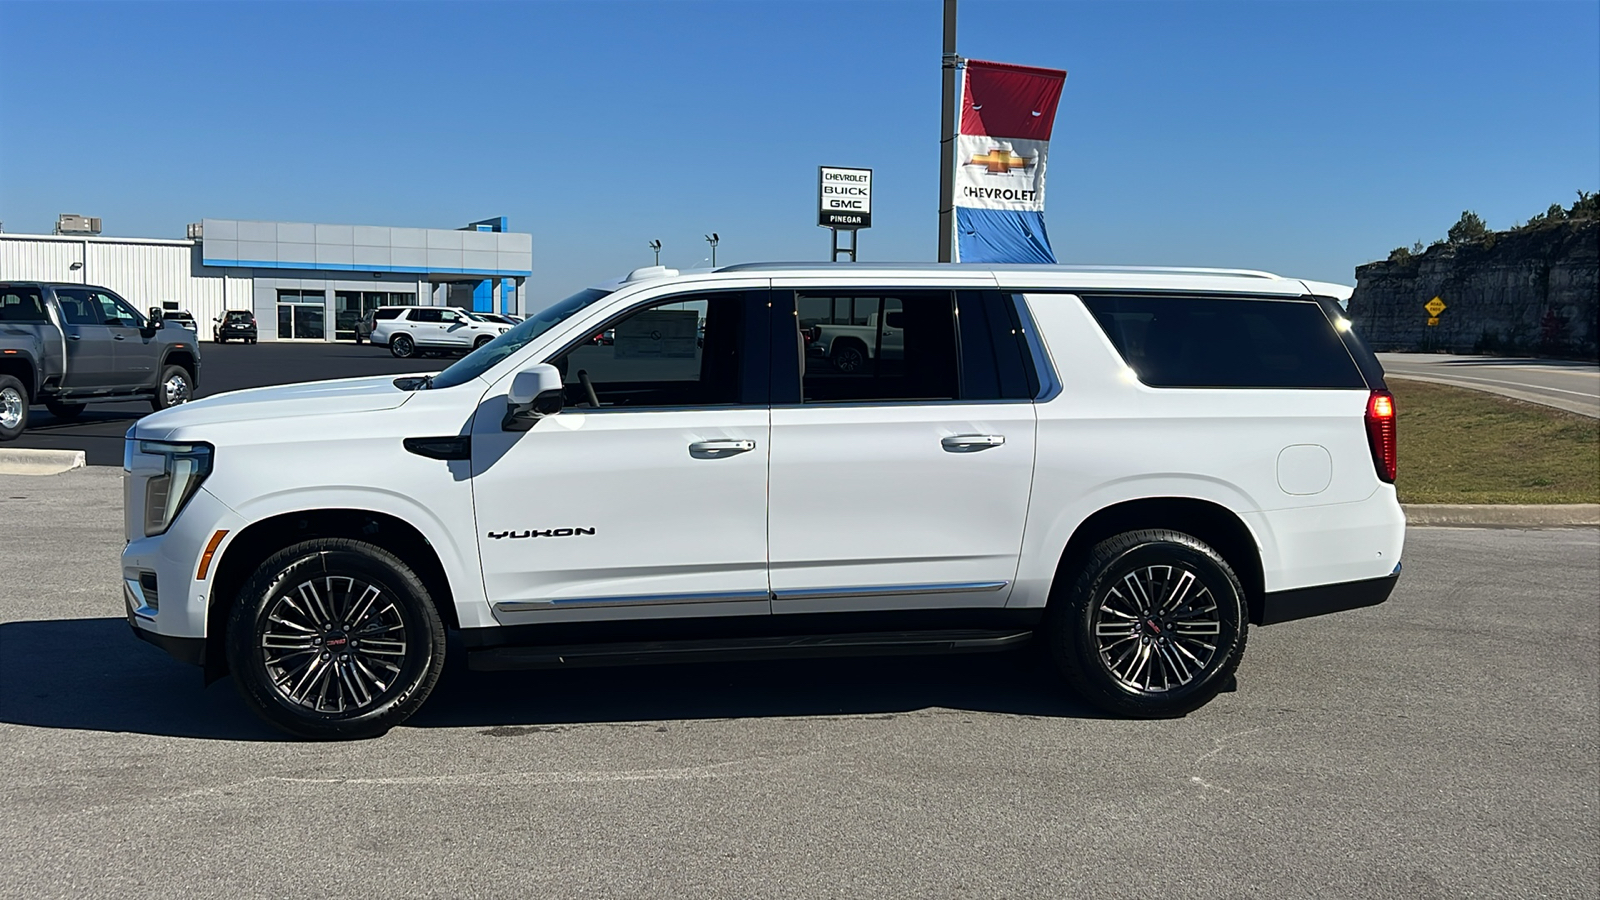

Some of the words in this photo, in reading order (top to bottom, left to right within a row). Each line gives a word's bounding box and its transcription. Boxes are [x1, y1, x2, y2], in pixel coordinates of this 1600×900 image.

[825, 173, 868, 182] CHEVROLET
[824, 186, 868, 196] BUICK
[963, 185, 1035, 202] CHEVROLET
[830, 199, 862, 209] GMC
[830, 215, 862, 224] PINEGAR
[487, 527, 596, 540] YUKON
